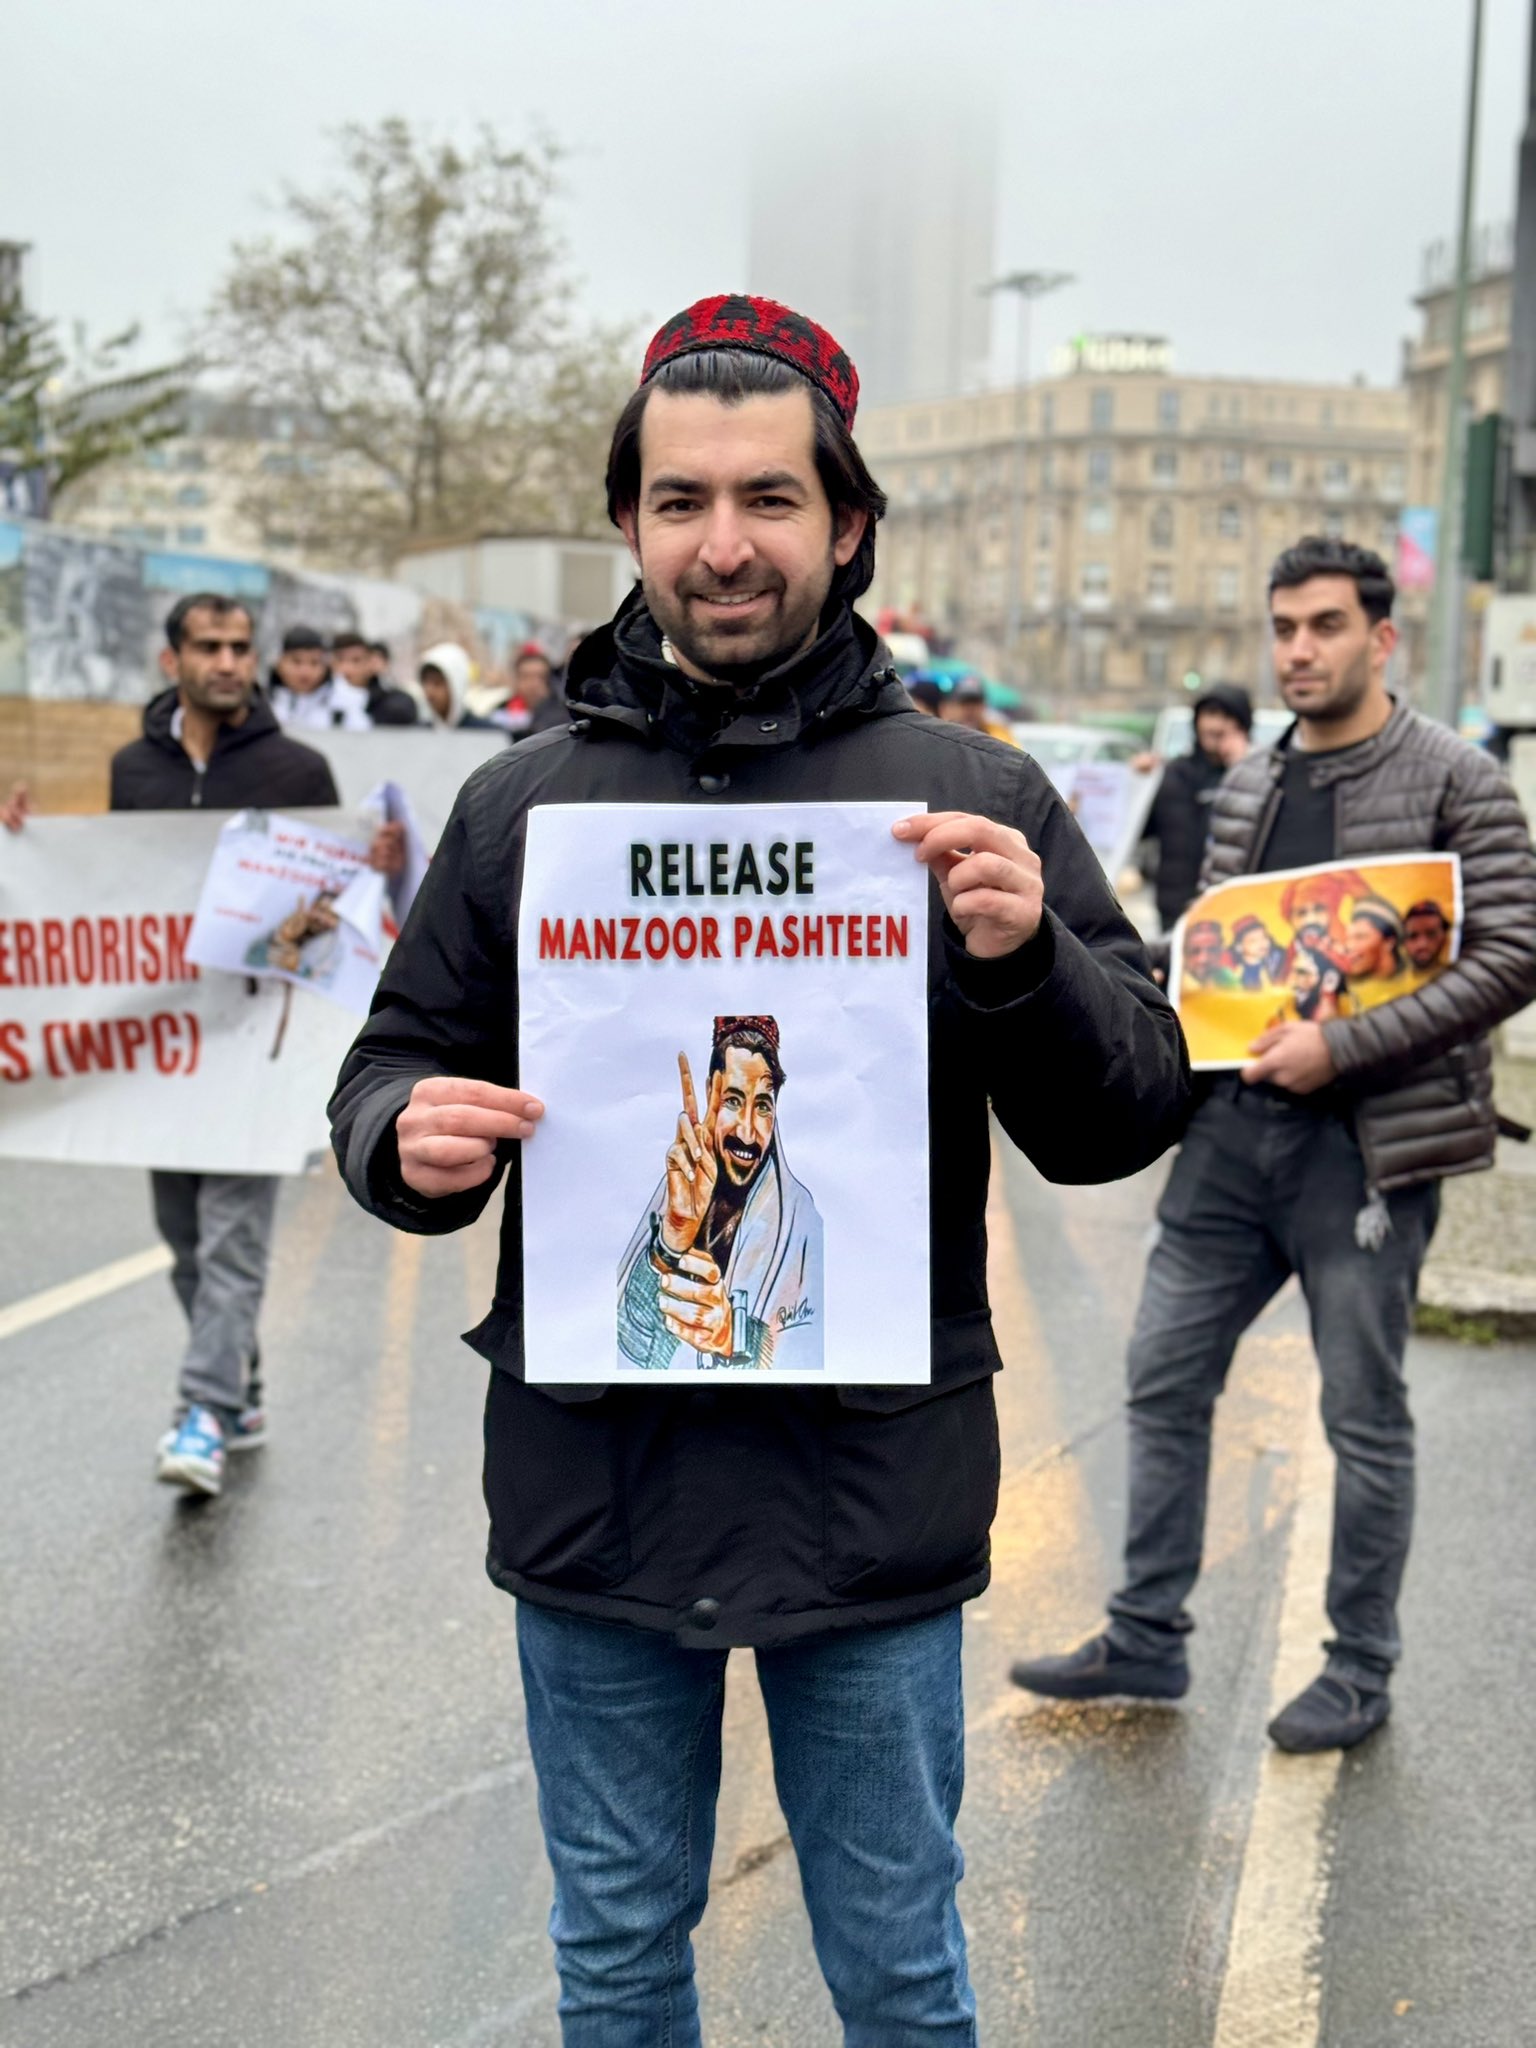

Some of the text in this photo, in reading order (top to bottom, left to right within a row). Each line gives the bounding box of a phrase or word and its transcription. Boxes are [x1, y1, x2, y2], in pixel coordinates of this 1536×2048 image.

[630, 841, 814, 897] RELEASE
[539, 914, 908, 960] MANZOOR PASHTEEN
[42, 1010, 201, 1080] (WPC)
